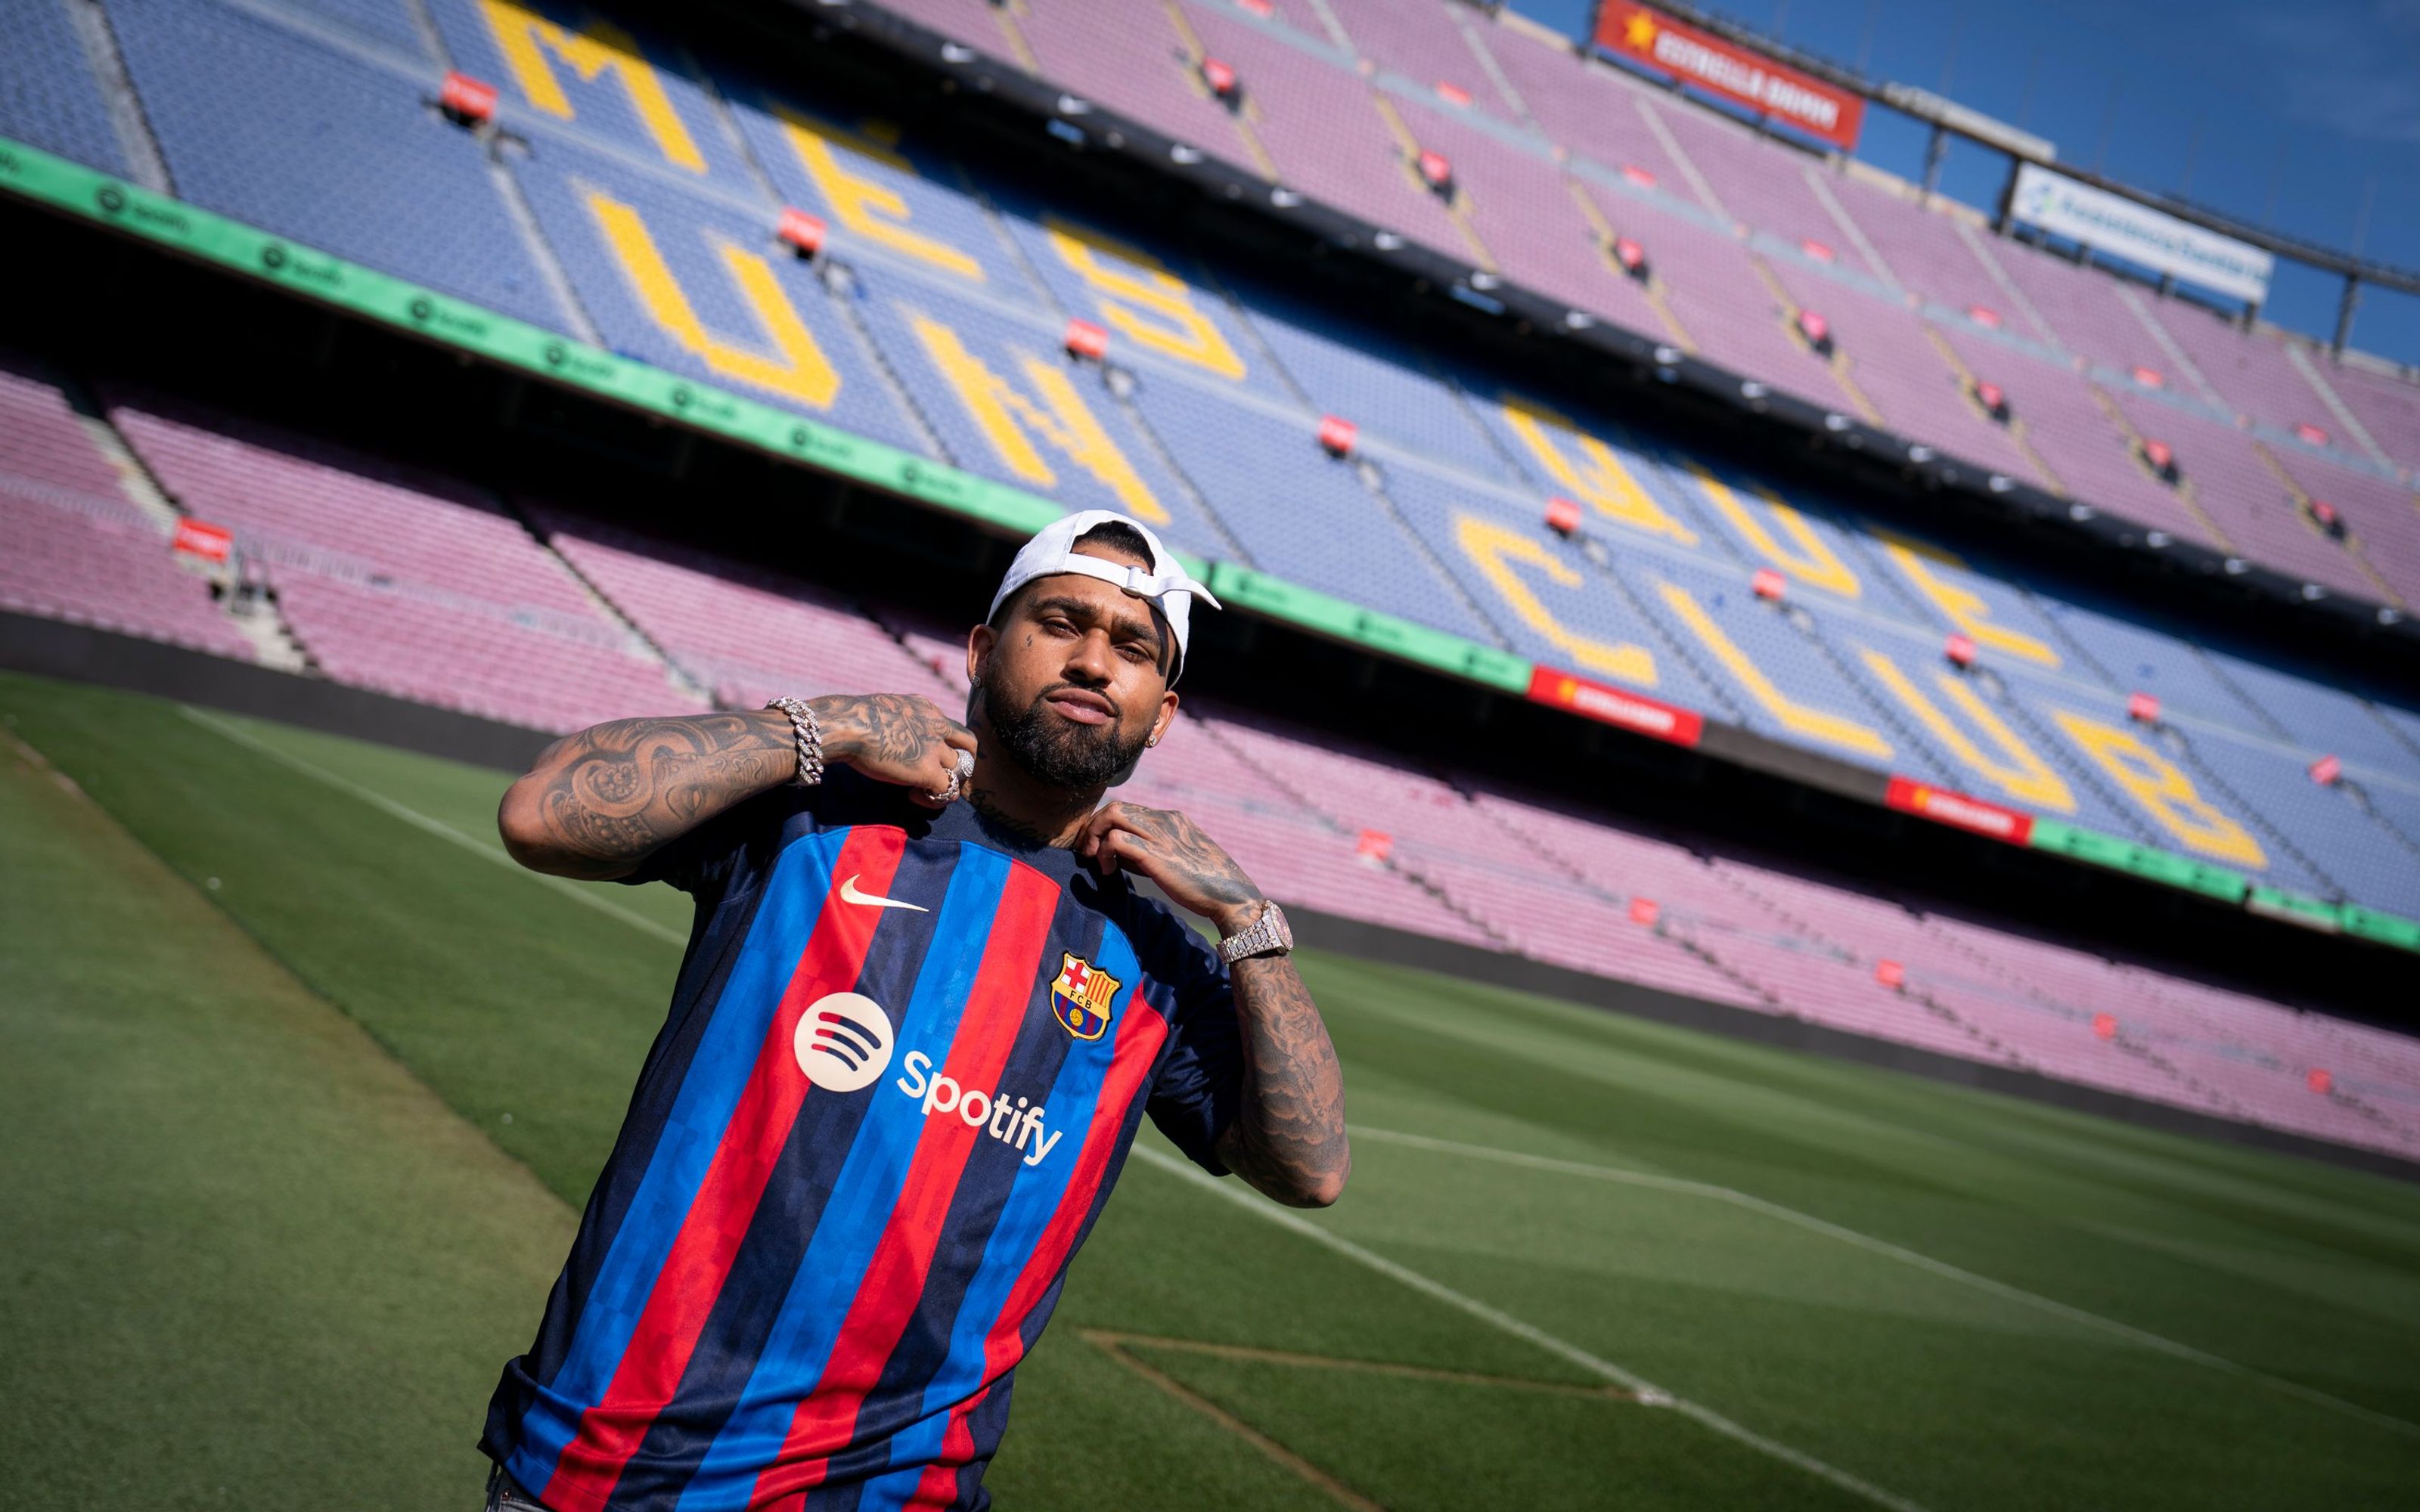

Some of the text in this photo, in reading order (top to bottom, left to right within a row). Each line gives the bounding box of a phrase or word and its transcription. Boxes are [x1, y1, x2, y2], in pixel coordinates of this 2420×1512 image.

[584, 181, 2269, 869] UN CLUB
[1500, 395, 2062, 668] QUE
[896, 1050, 1063, 1167] Spotify
